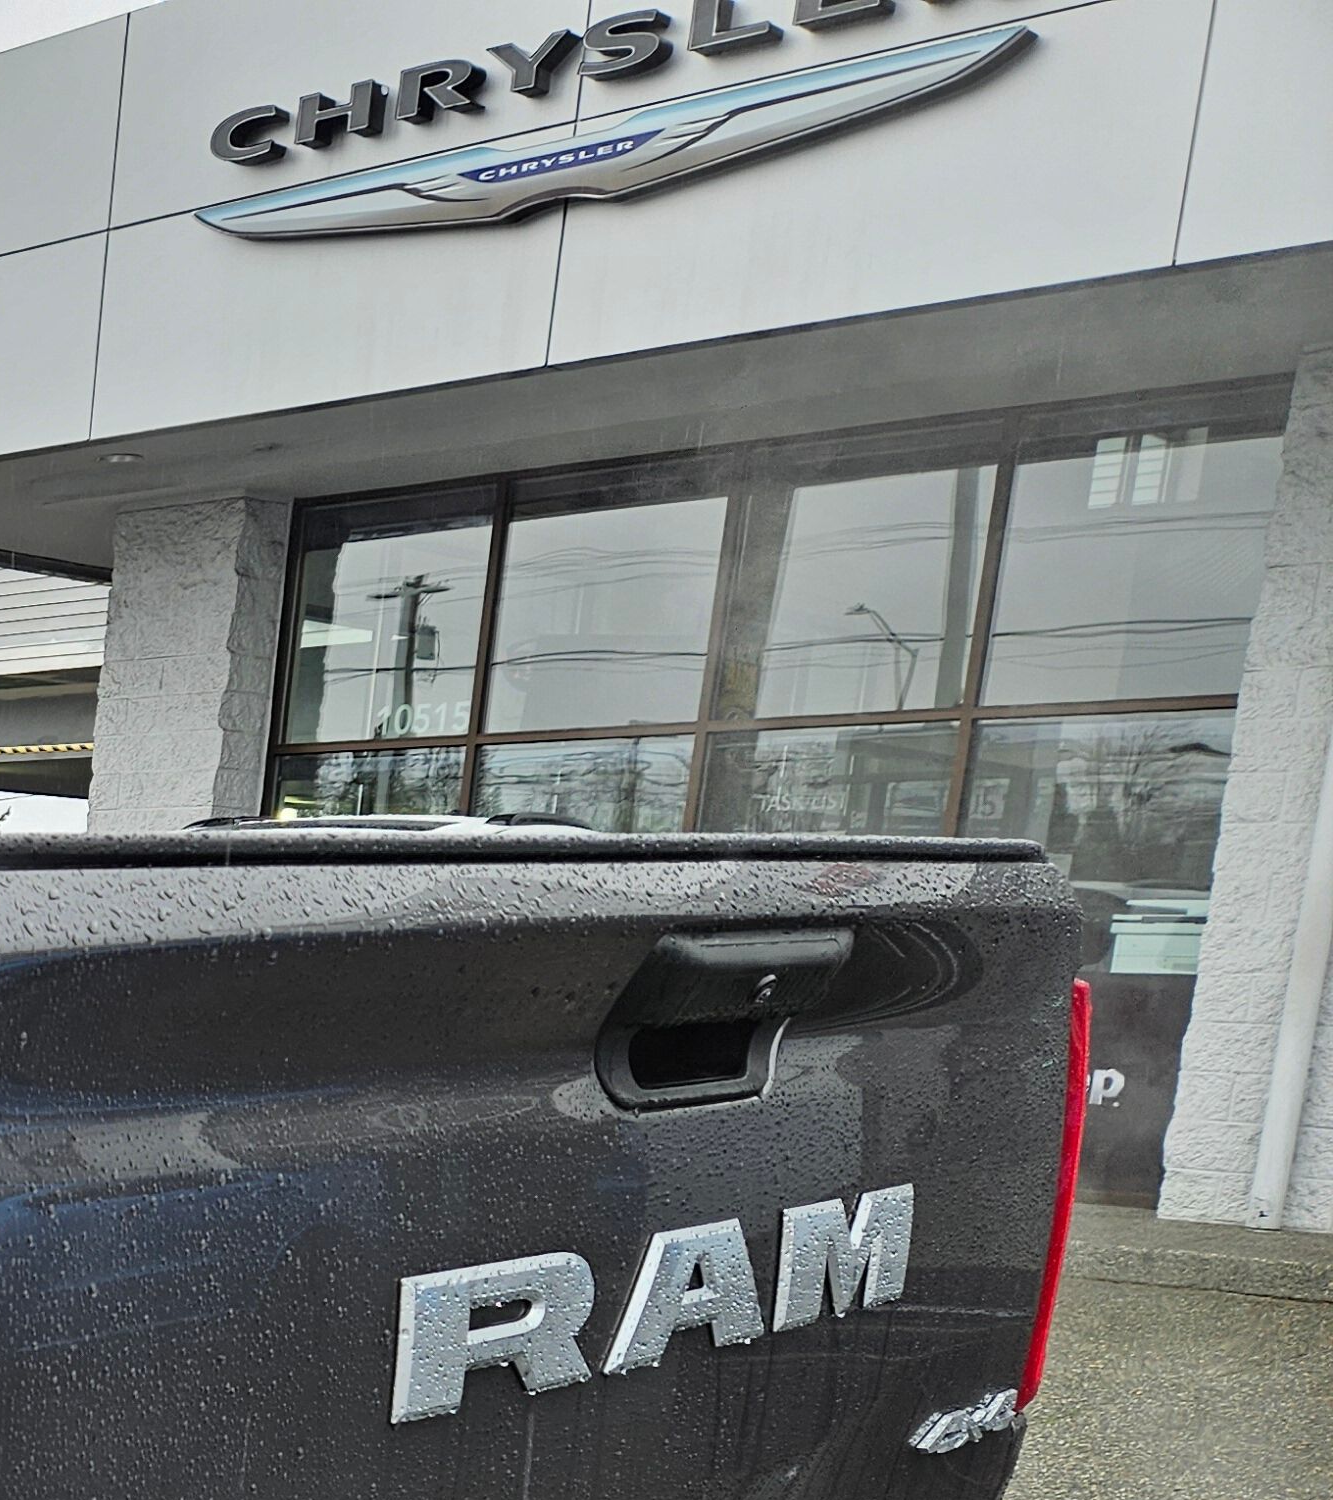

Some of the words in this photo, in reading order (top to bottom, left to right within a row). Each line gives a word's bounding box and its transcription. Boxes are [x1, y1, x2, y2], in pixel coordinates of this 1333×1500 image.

[478, 140, 634, 181] CHRYSLER
[377, 700, 470, 735] 10515
[390, 1182, 914, 1424] RAM
